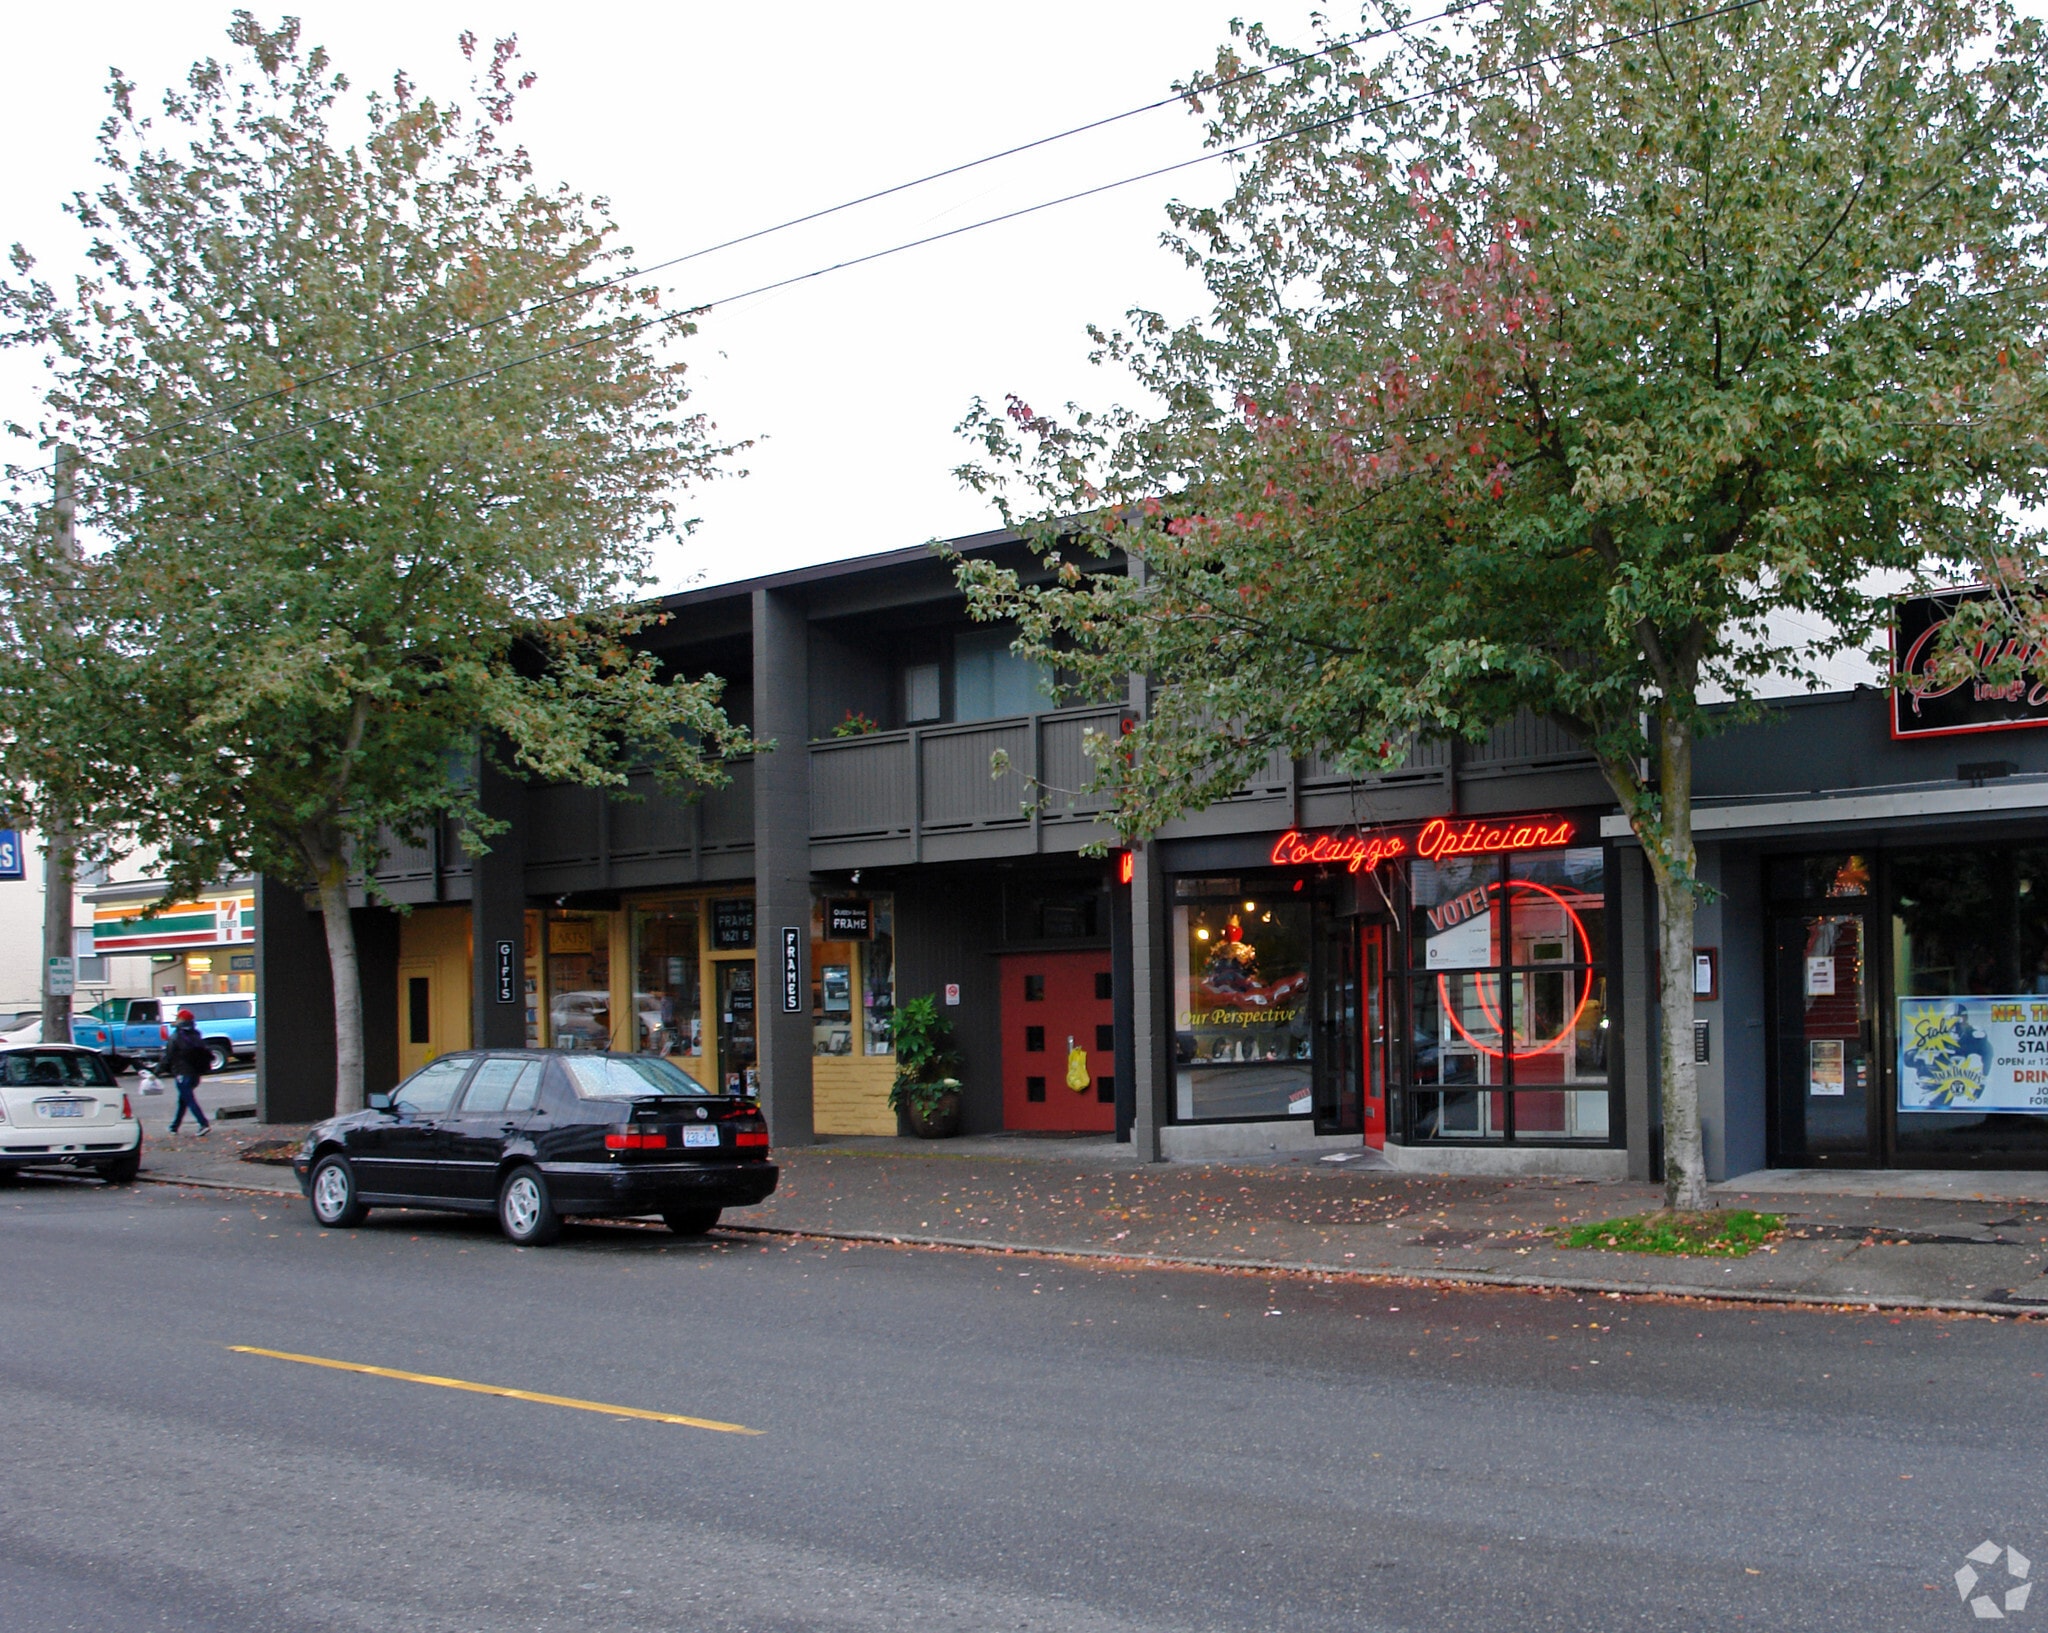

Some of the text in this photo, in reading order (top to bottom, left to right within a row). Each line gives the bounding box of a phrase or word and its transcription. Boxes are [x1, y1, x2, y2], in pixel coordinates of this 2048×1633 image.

[0, 843, 14, 867] S
[1272, 819, 1570, 872] Colaizzo Opticians
[1427, 885, 1490, 931] VOTE!
[719, 914, 753, 927] FRAME
[833, 918, 867, 930] FRAME
[558, 932, 585, 944] ARTS
[500, 944, 511, 999] GIFTS
[786, 933, 797, 1008] FRAMES
[1181, 1006, 1296, 1028] Our Perspective
[1991, 1003, 2027, 1022] NFL
[2018, 1041, 2048, 1053] STA
[1997, 1057, 2025, 1066] OPEN
